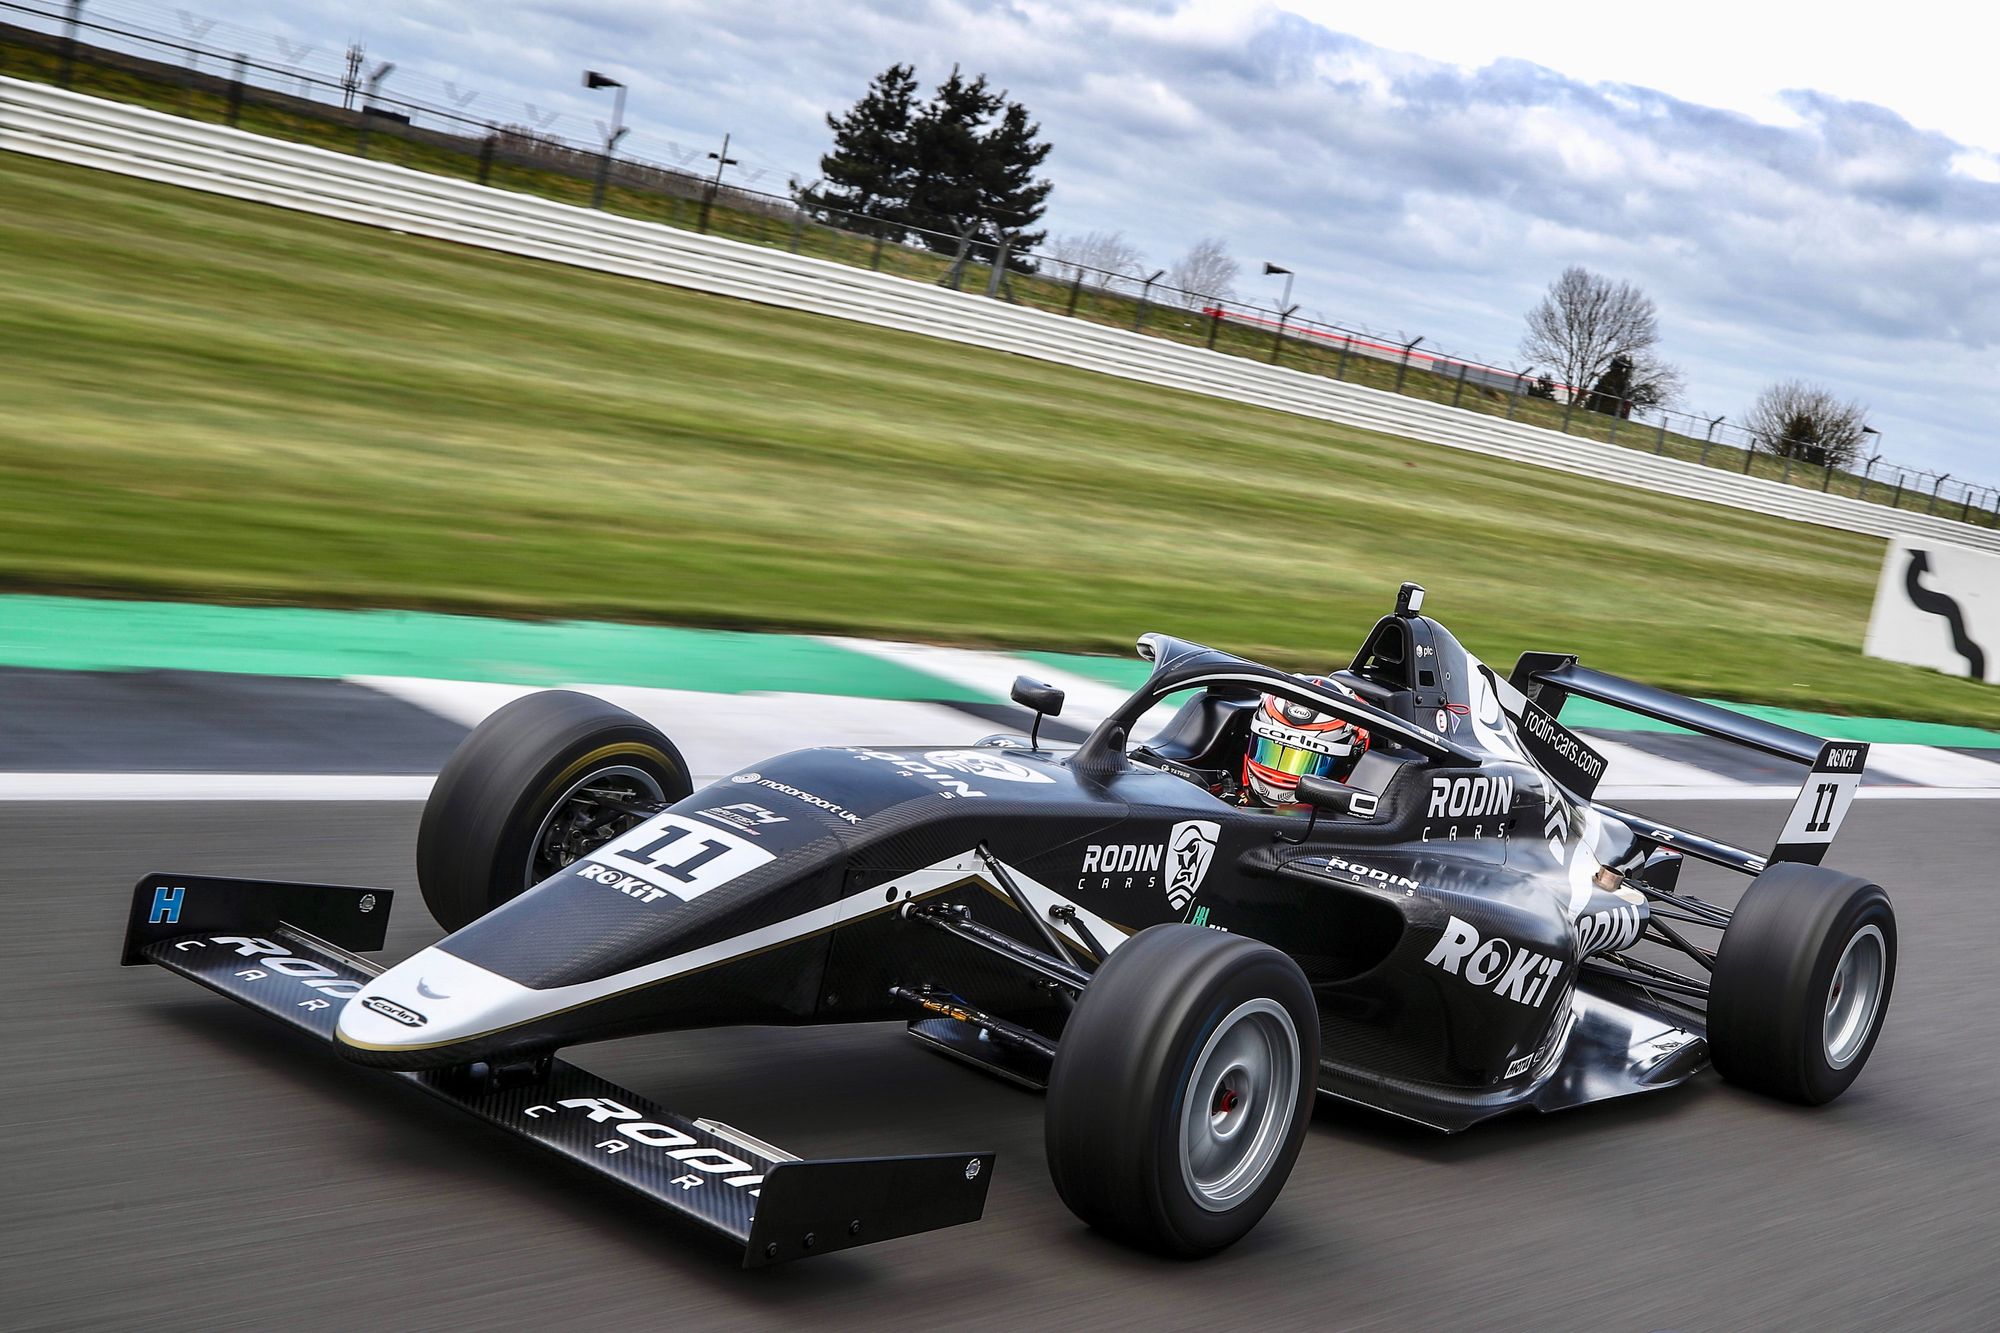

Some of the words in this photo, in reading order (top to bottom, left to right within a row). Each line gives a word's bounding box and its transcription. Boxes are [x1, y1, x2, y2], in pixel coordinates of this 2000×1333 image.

[1258, 727, 1330, 754] carlin
[1524, 710, 1602, 780] rodin-cars.com
[846, 747, 988, 798] ODIN
[721, 803, 790, 823] F4
[757, 779, 843, 813] motorsport
[838, 810, 862, 825] UK
[1427, 776, 1513, 818] RODIN
[1804, 783, 1839, 832] 11
[1422, 822, 1504, 843] CARS
[613, 824, 733, 883] 11
[1081, 844, 1164, 873] RODIN
[1077, 876, 1156, 890] CARS
[1325, 866, 1415, 897] CARS
[1328, 858, 1420, 890] RODIN
[149, 886, 186, 924] H
[1574, 905, 1640, 962] ODIN
[209, 936, 364, 999] ROD
[374, 1001, 415, 1022] carlin
[557, 1098, 765, 1198] RODI
